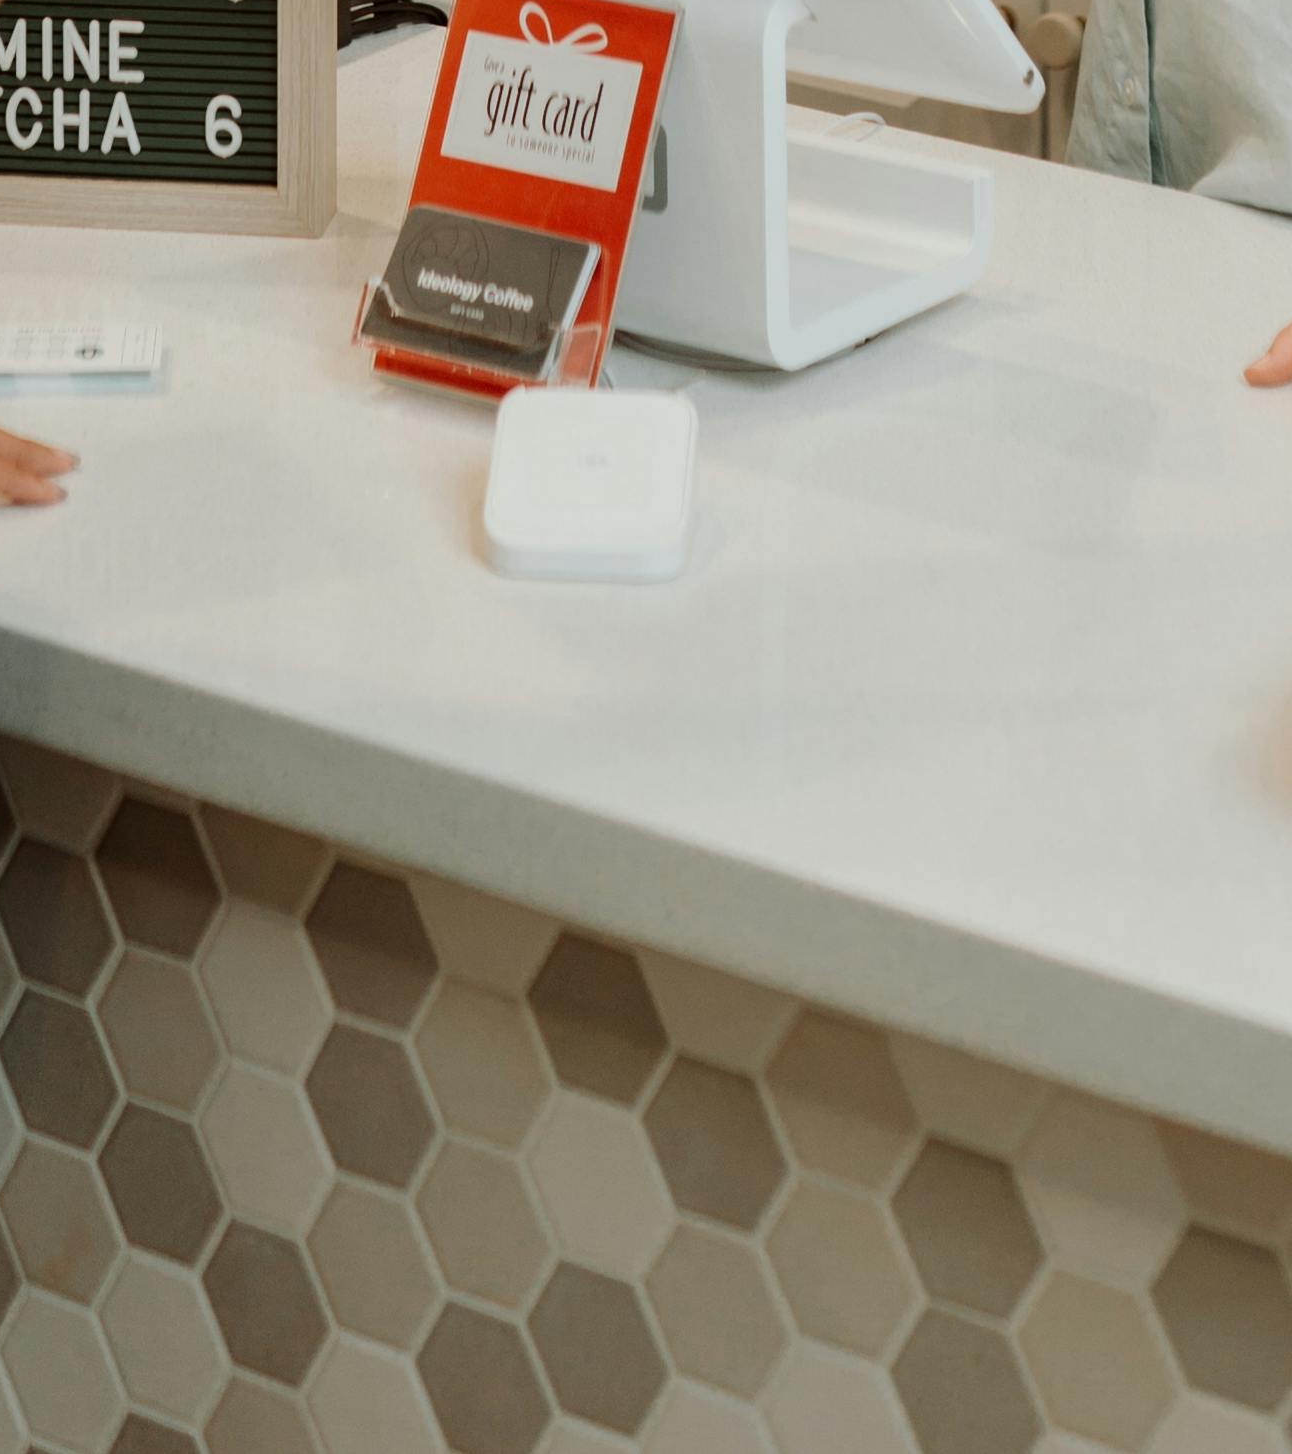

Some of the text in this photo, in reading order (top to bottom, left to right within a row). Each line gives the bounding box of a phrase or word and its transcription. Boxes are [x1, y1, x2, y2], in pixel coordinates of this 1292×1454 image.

[204, 93, 243, 158] 6
[484, 65, 604, 143] gift card
[520, 138, 558, 156] someone
[563, 144, 596, 164] special
[417, 267, 533, 313] Ideology Coffee
